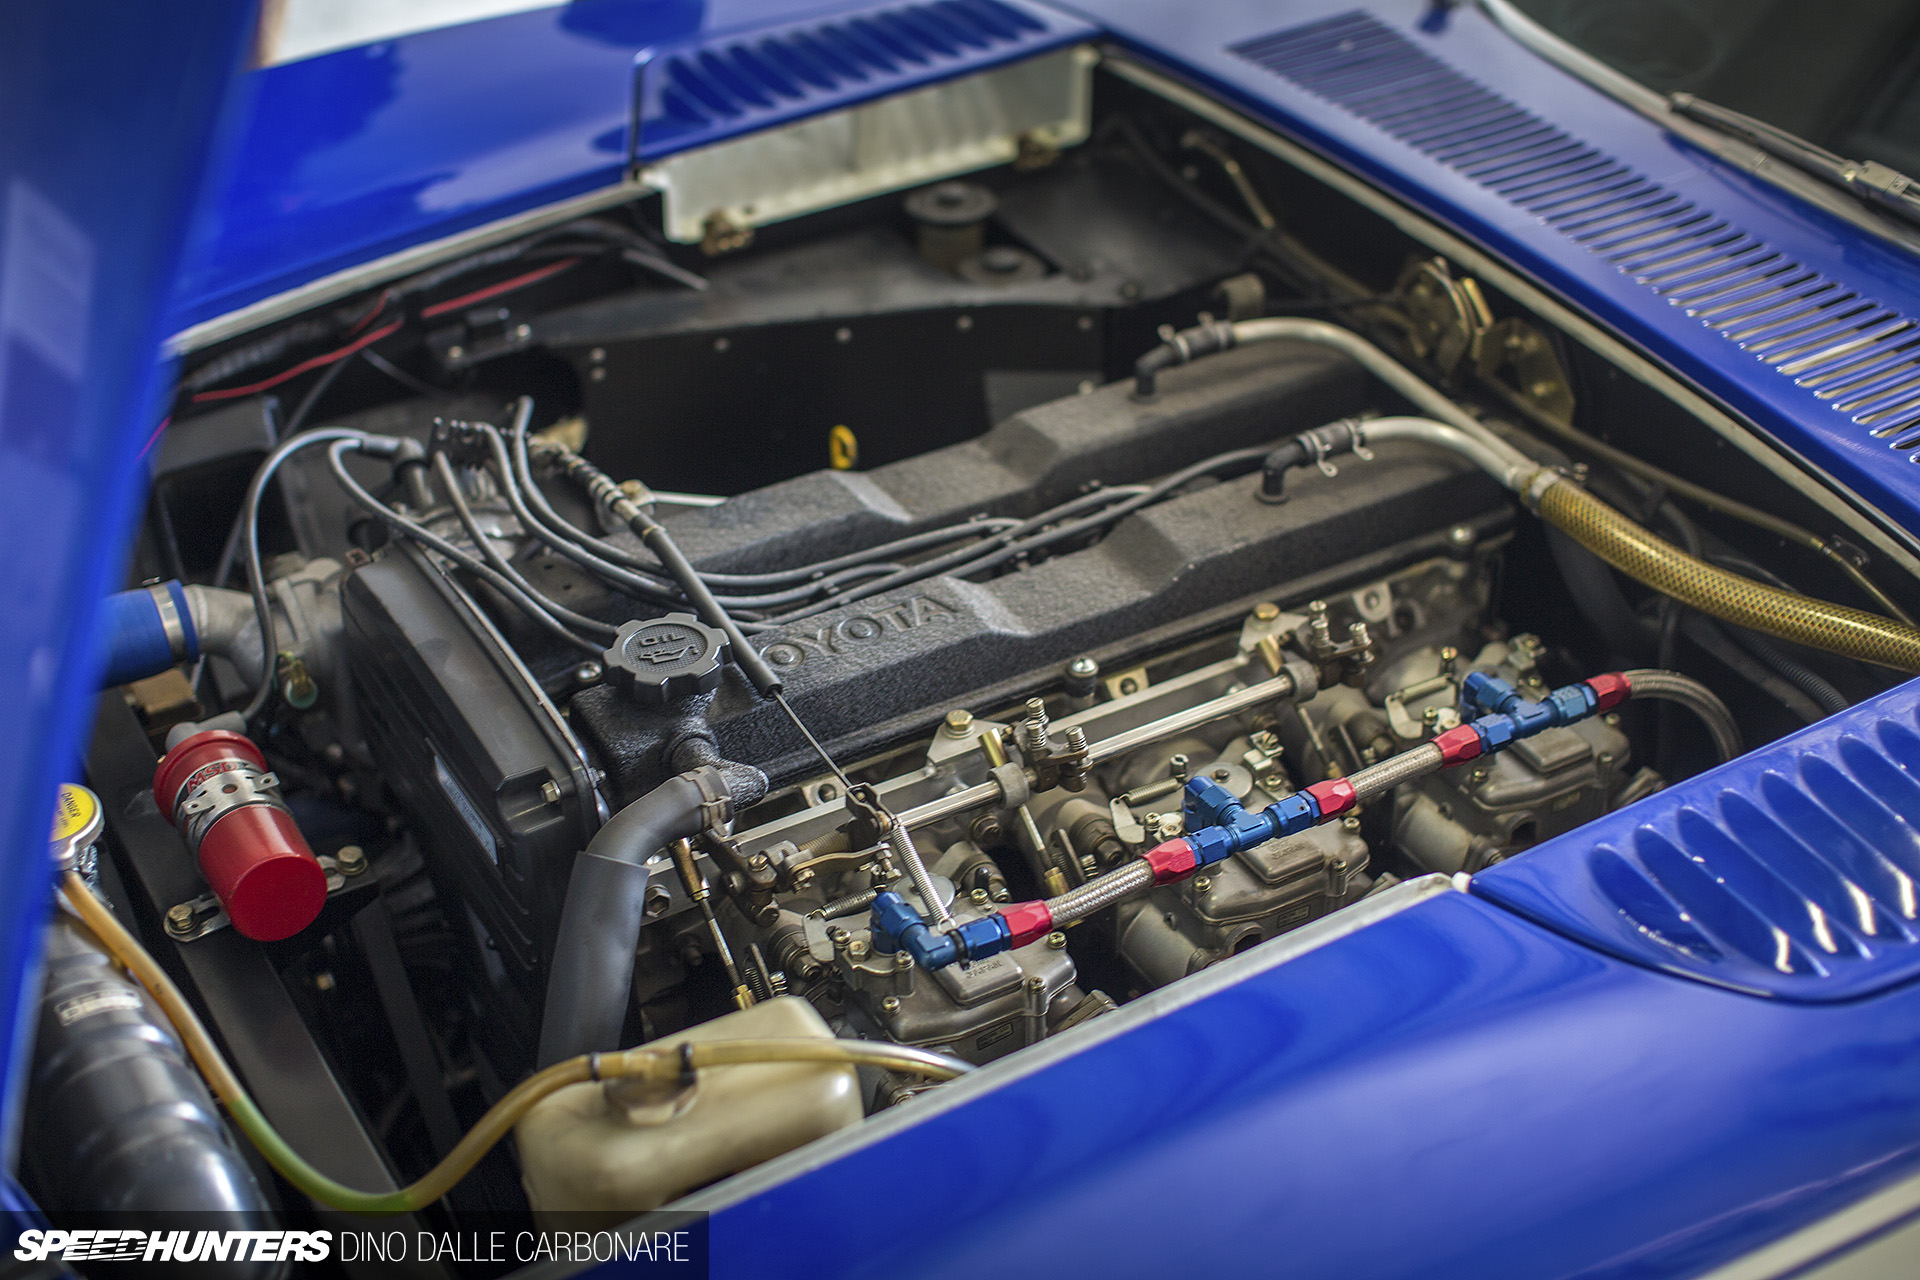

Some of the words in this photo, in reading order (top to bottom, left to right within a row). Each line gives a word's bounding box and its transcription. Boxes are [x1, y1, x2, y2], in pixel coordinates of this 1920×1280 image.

[640, 632, 686, 647] OIL
[758, 594, 958, 670] OYOTA
[186, 761, 239, 795] MSD
[61, 791, 82, 819] DANGER
